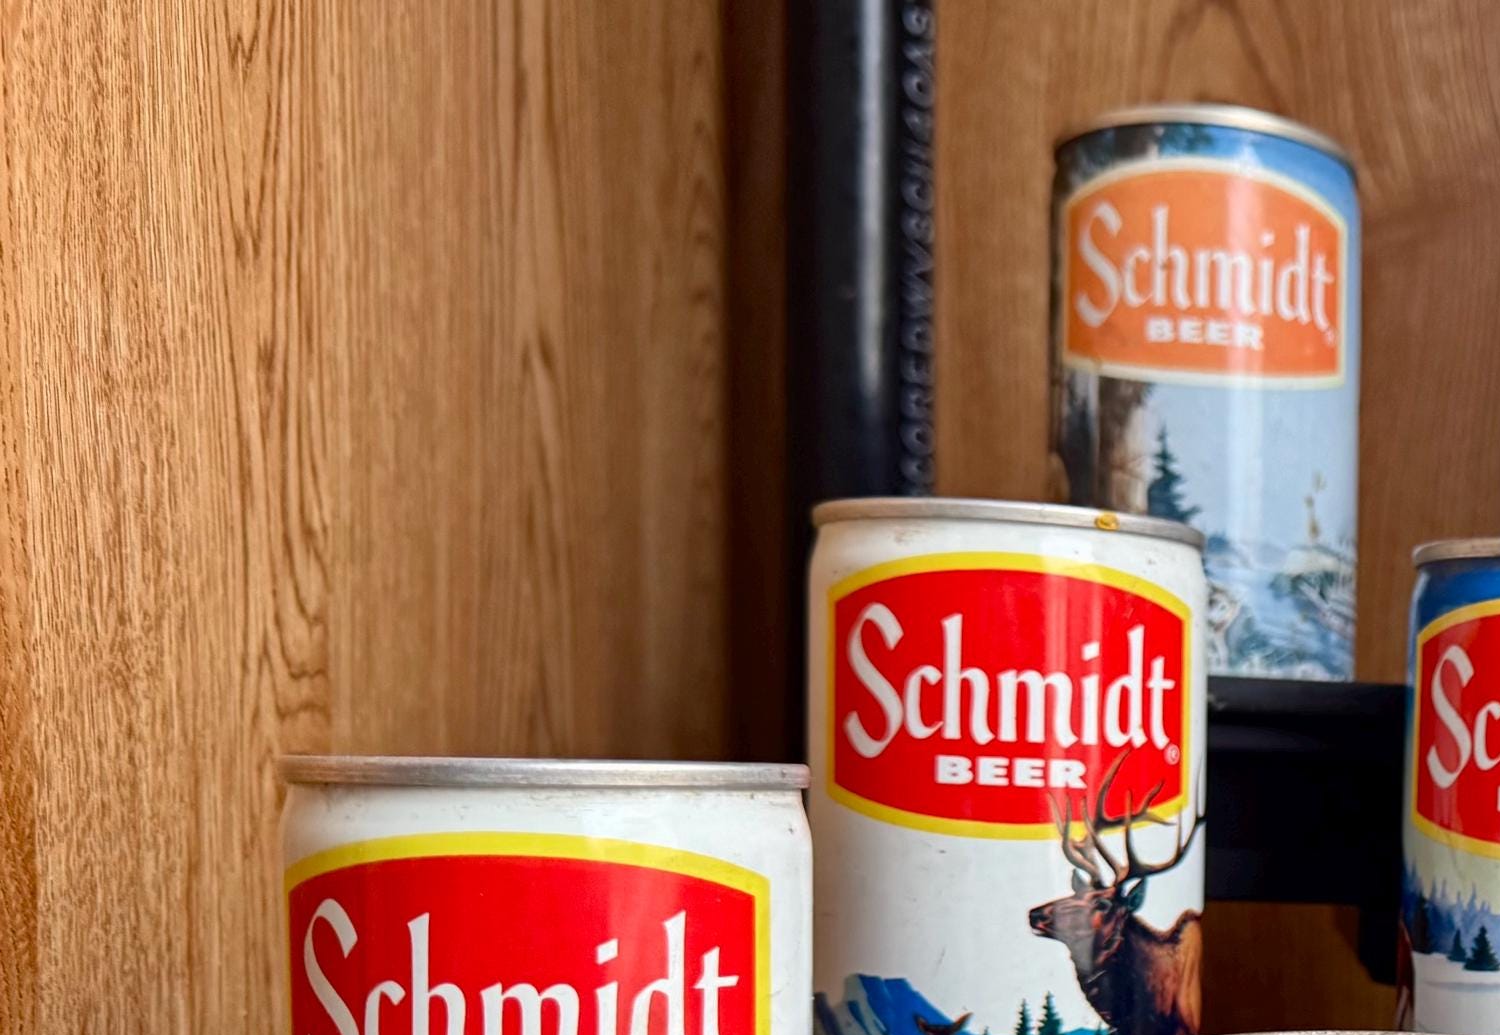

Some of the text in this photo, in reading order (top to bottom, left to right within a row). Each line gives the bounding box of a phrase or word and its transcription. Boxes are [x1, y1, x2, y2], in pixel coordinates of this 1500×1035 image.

[1075, 200, 1334, 333] Schmidt
[1145, 316, 1264, 350] BEER
[843, 602, 1175, 758] Schmidt
[934, 754, 1088, 789] BEER
